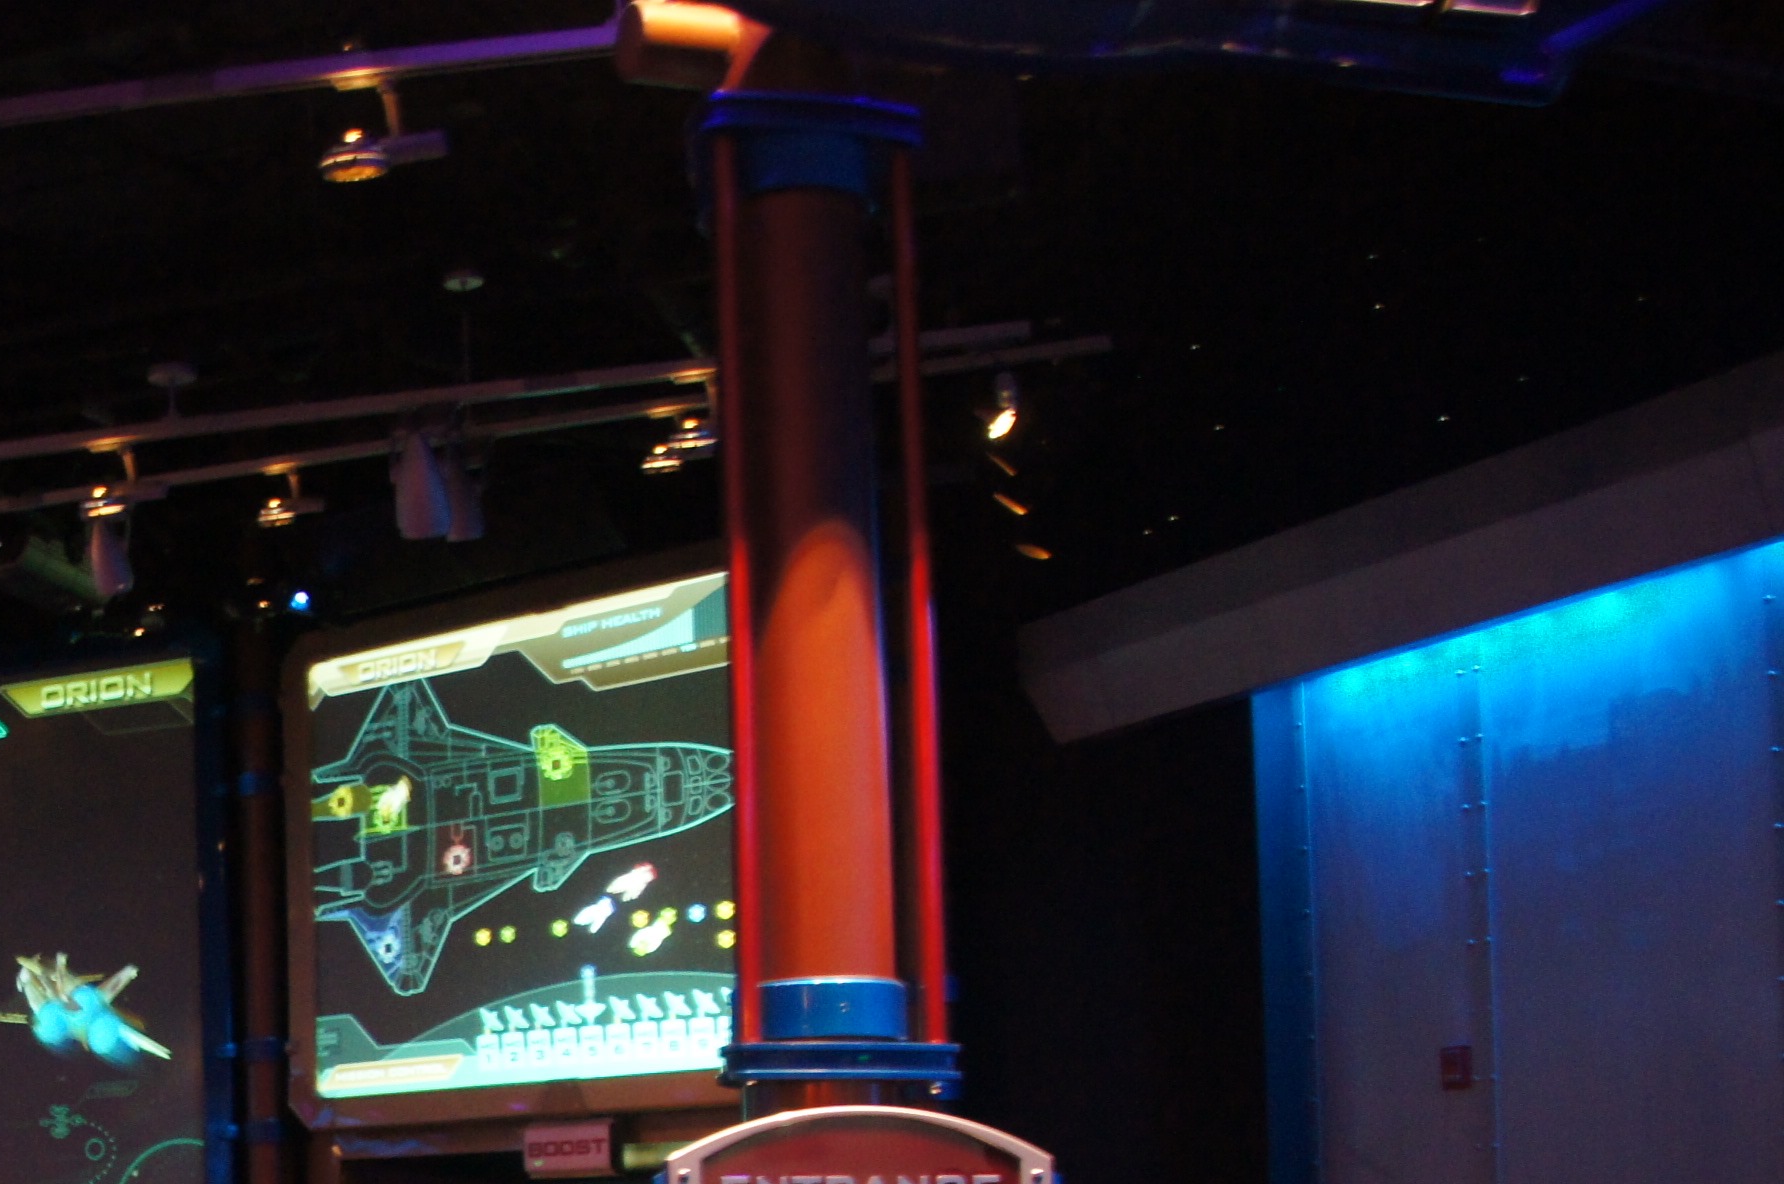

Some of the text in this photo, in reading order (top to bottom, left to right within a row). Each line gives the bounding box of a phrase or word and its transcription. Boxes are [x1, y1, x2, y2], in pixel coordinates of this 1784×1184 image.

[562, 607, 662, 638] SHIP HEALTH
[358, 648, 437, 683] ORION
[40, 671, 153, 710] ORION
[528, 1137, 606, 1158] BOOST
